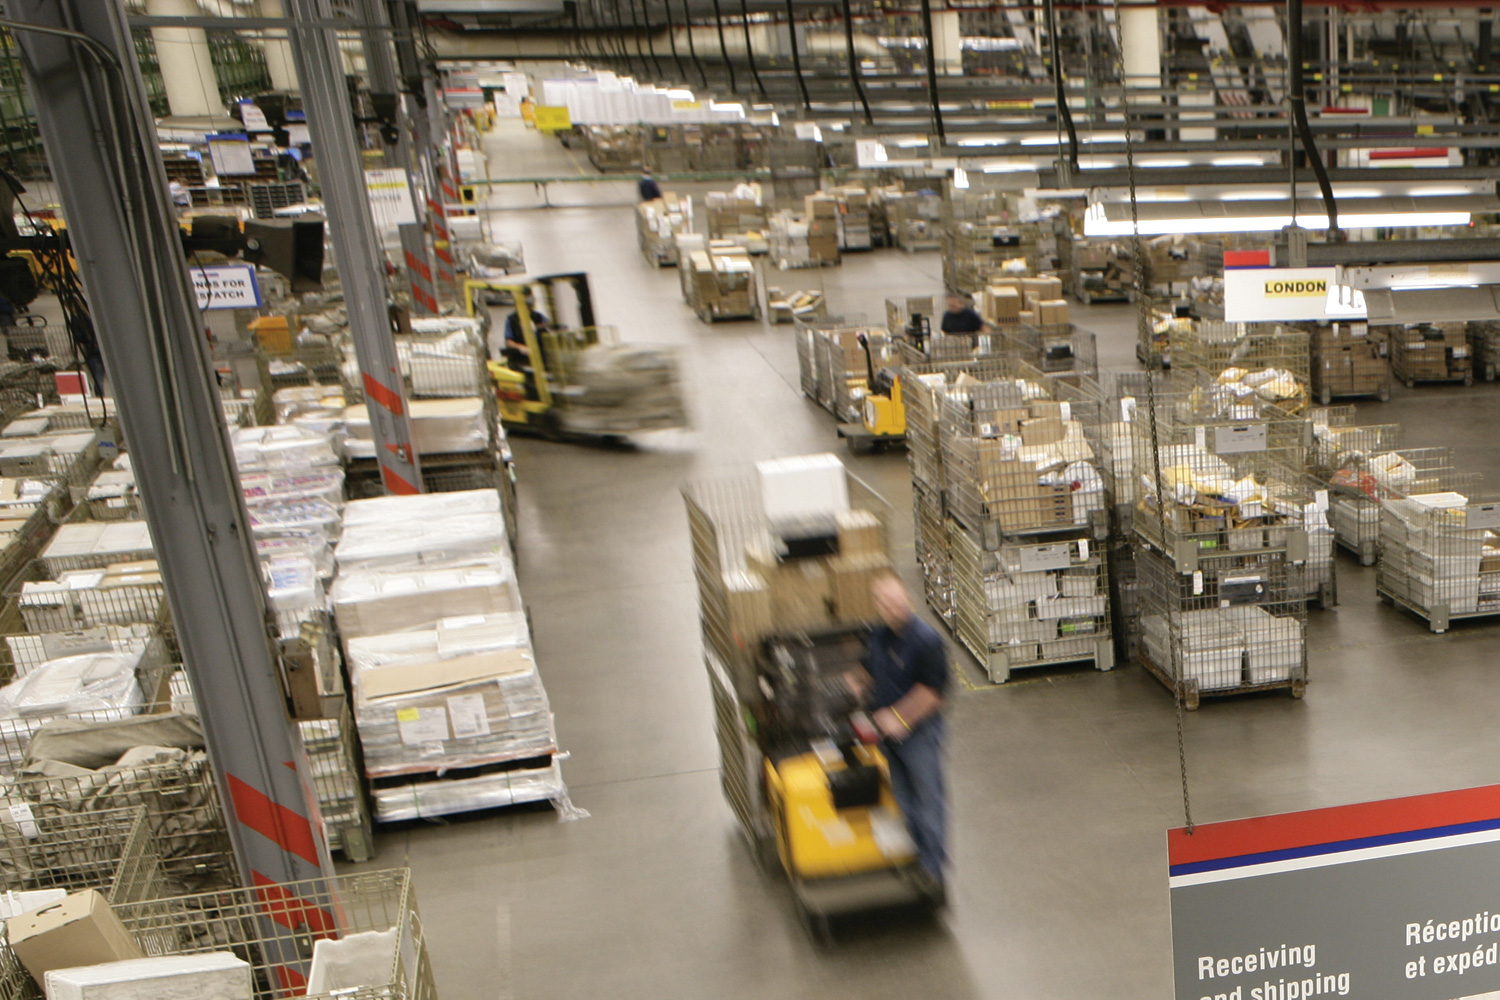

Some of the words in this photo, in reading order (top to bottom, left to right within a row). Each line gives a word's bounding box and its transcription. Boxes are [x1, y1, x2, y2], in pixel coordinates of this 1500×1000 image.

[222, 279, 246, 289] FOR
[1265, 281, 1326, 294] LONDON
[199, 290, 245, 301] SPATCH
[1198, 943, 1317, 980] Receiving
[1405, 955, 1426, 979] et
